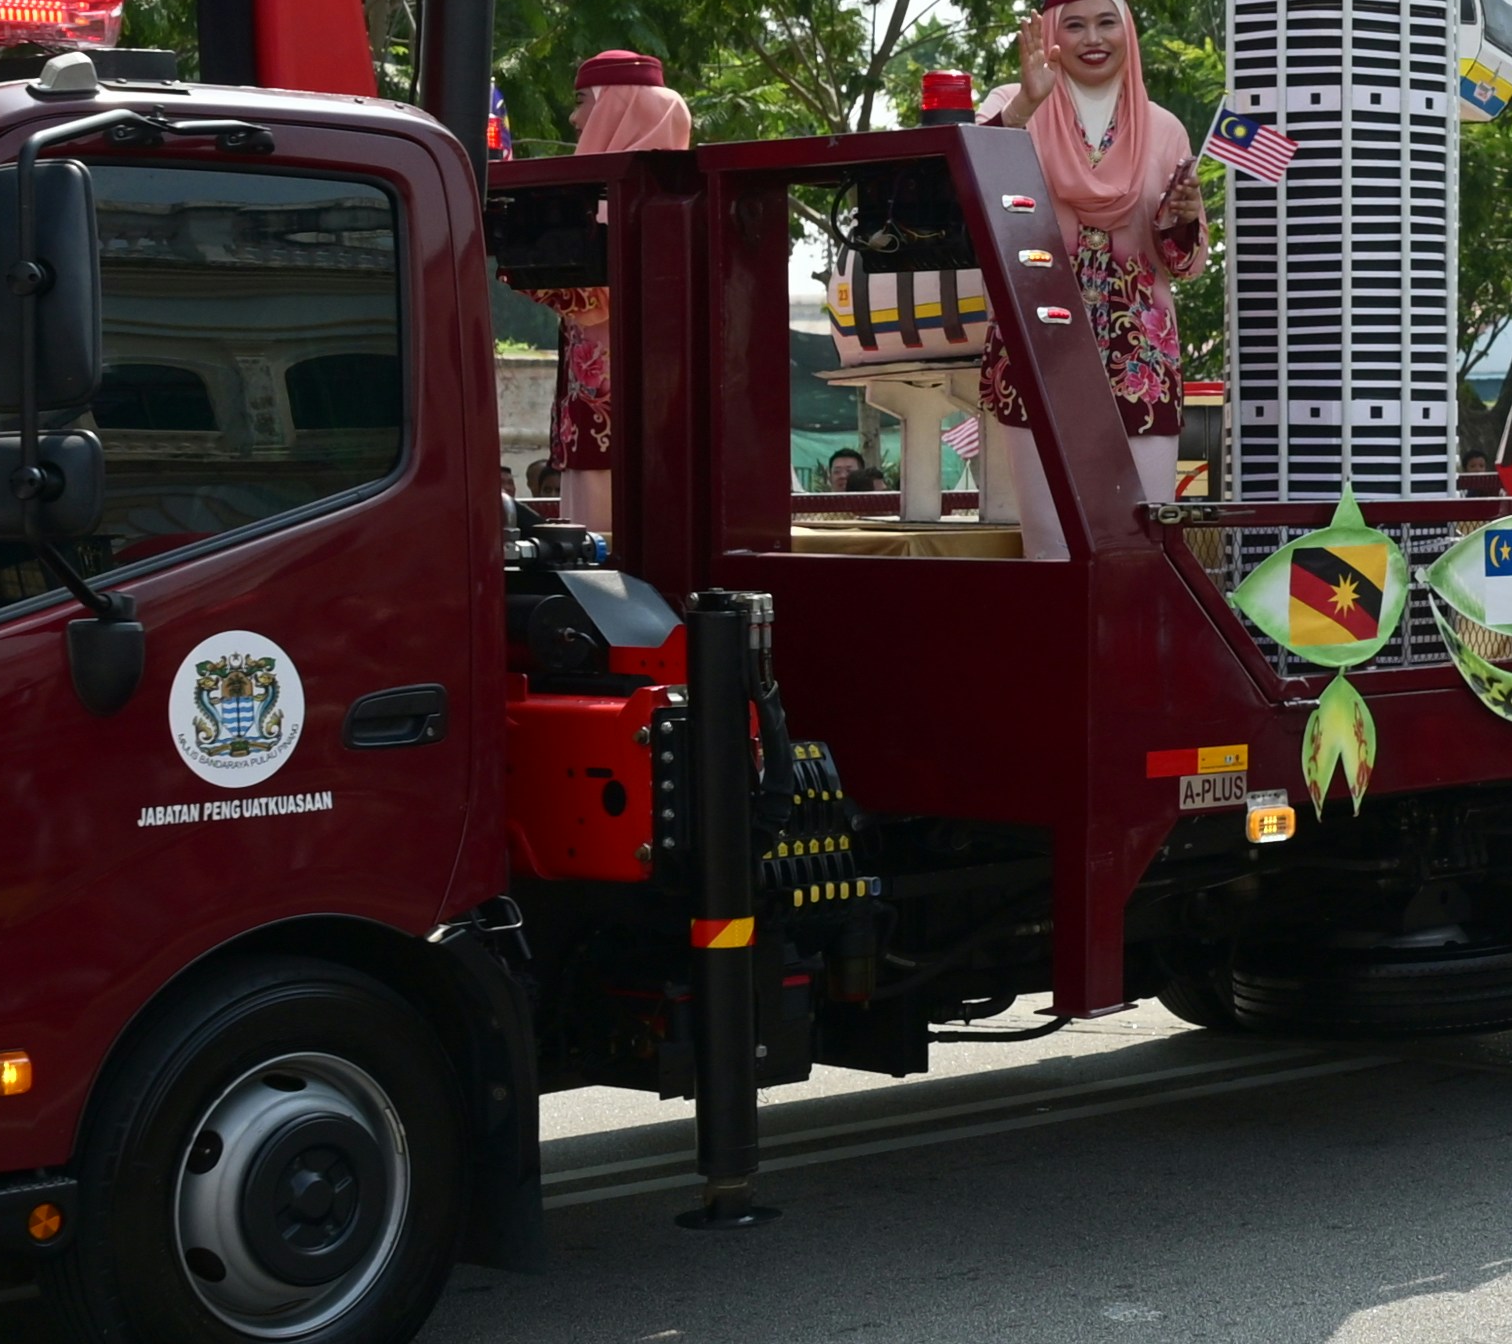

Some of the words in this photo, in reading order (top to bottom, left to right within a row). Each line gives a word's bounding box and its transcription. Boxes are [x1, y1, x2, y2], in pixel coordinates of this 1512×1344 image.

[177, 733, 199, 761] MAJLIS
[198, 754, 250, 770] BANDARAYA
[250, 749, 279, 768] PULAU
[277, 723, 299, 757] PINANG
[1183, 776, 1244, 805] A-PLUS
[137, 803, 200, 827] JABATAN
